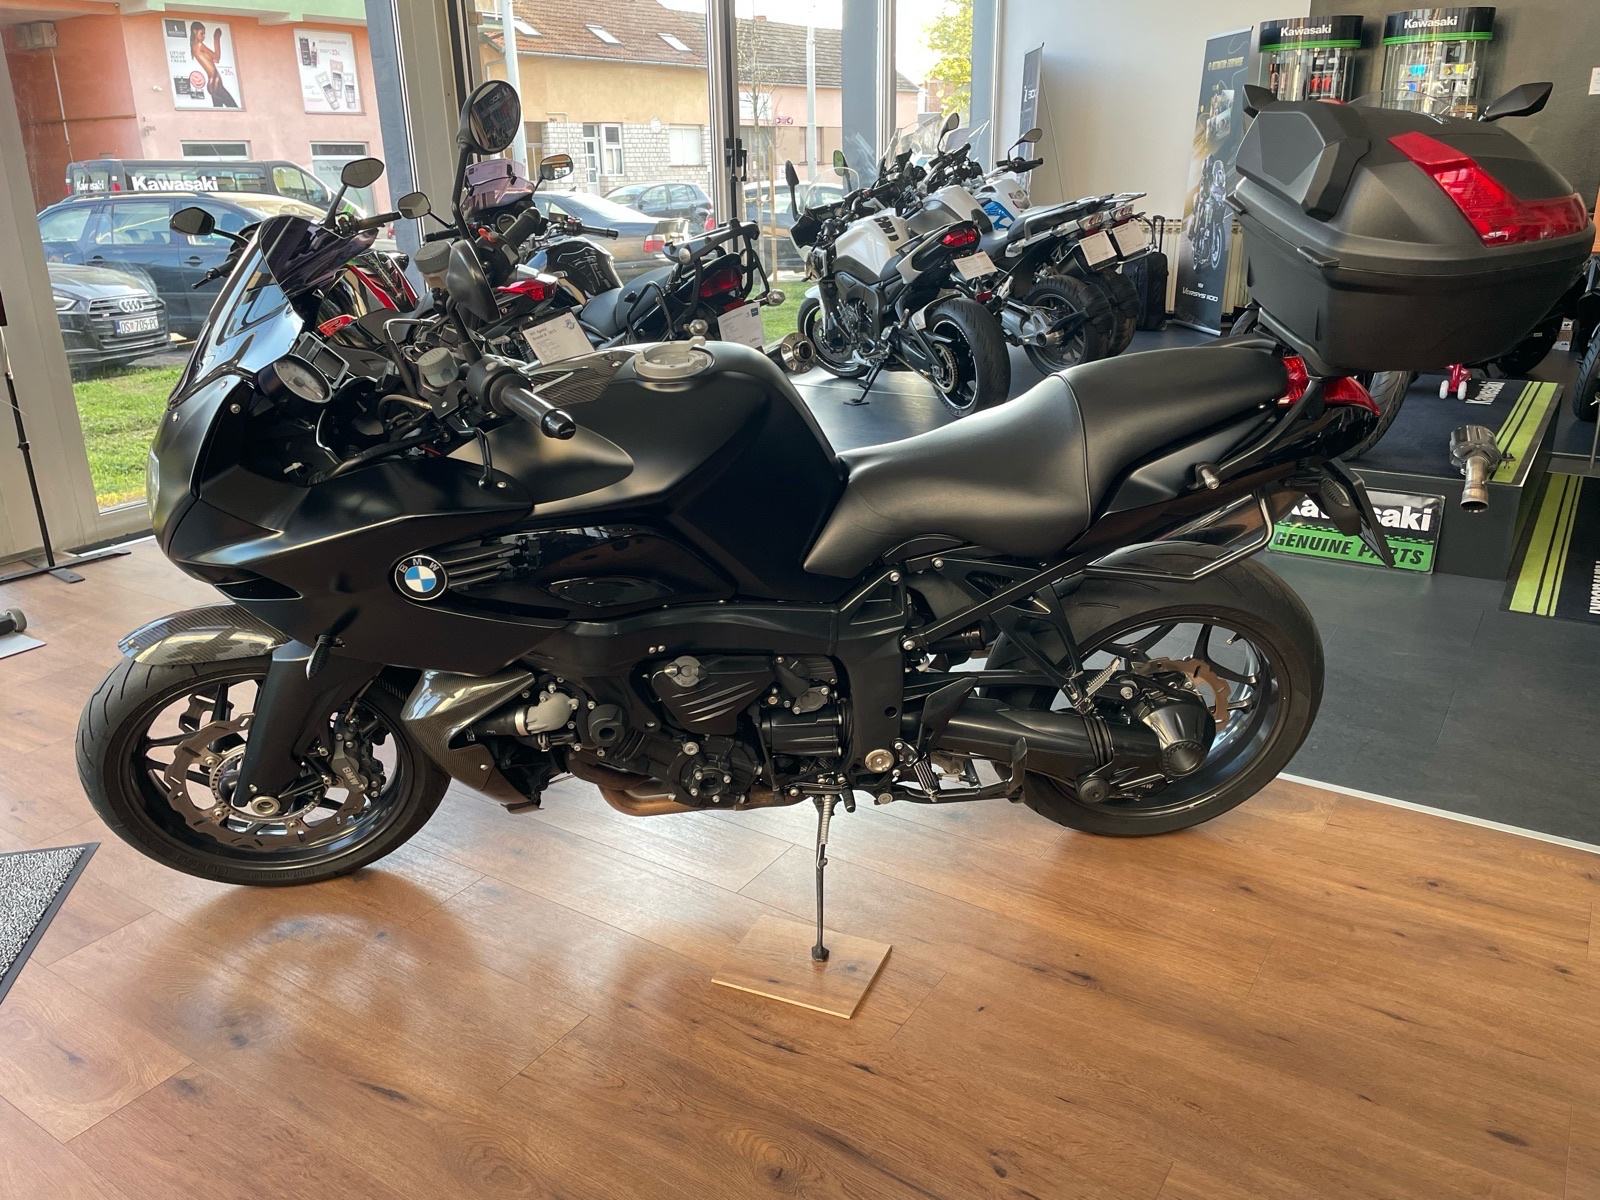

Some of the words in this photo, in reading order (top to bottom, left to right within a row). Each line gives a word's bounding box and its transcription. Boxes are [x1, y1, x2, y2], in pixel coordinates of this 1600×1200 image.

[1280, 24, 1332, 37] Kawasaki
[1404, 16, 1458, 29] Kawasaki
[131, 175, 218, 191] Kawasaki
[1274, 530, 1354, 556] GENUINE
[398, 557, 440, 573] BMW
